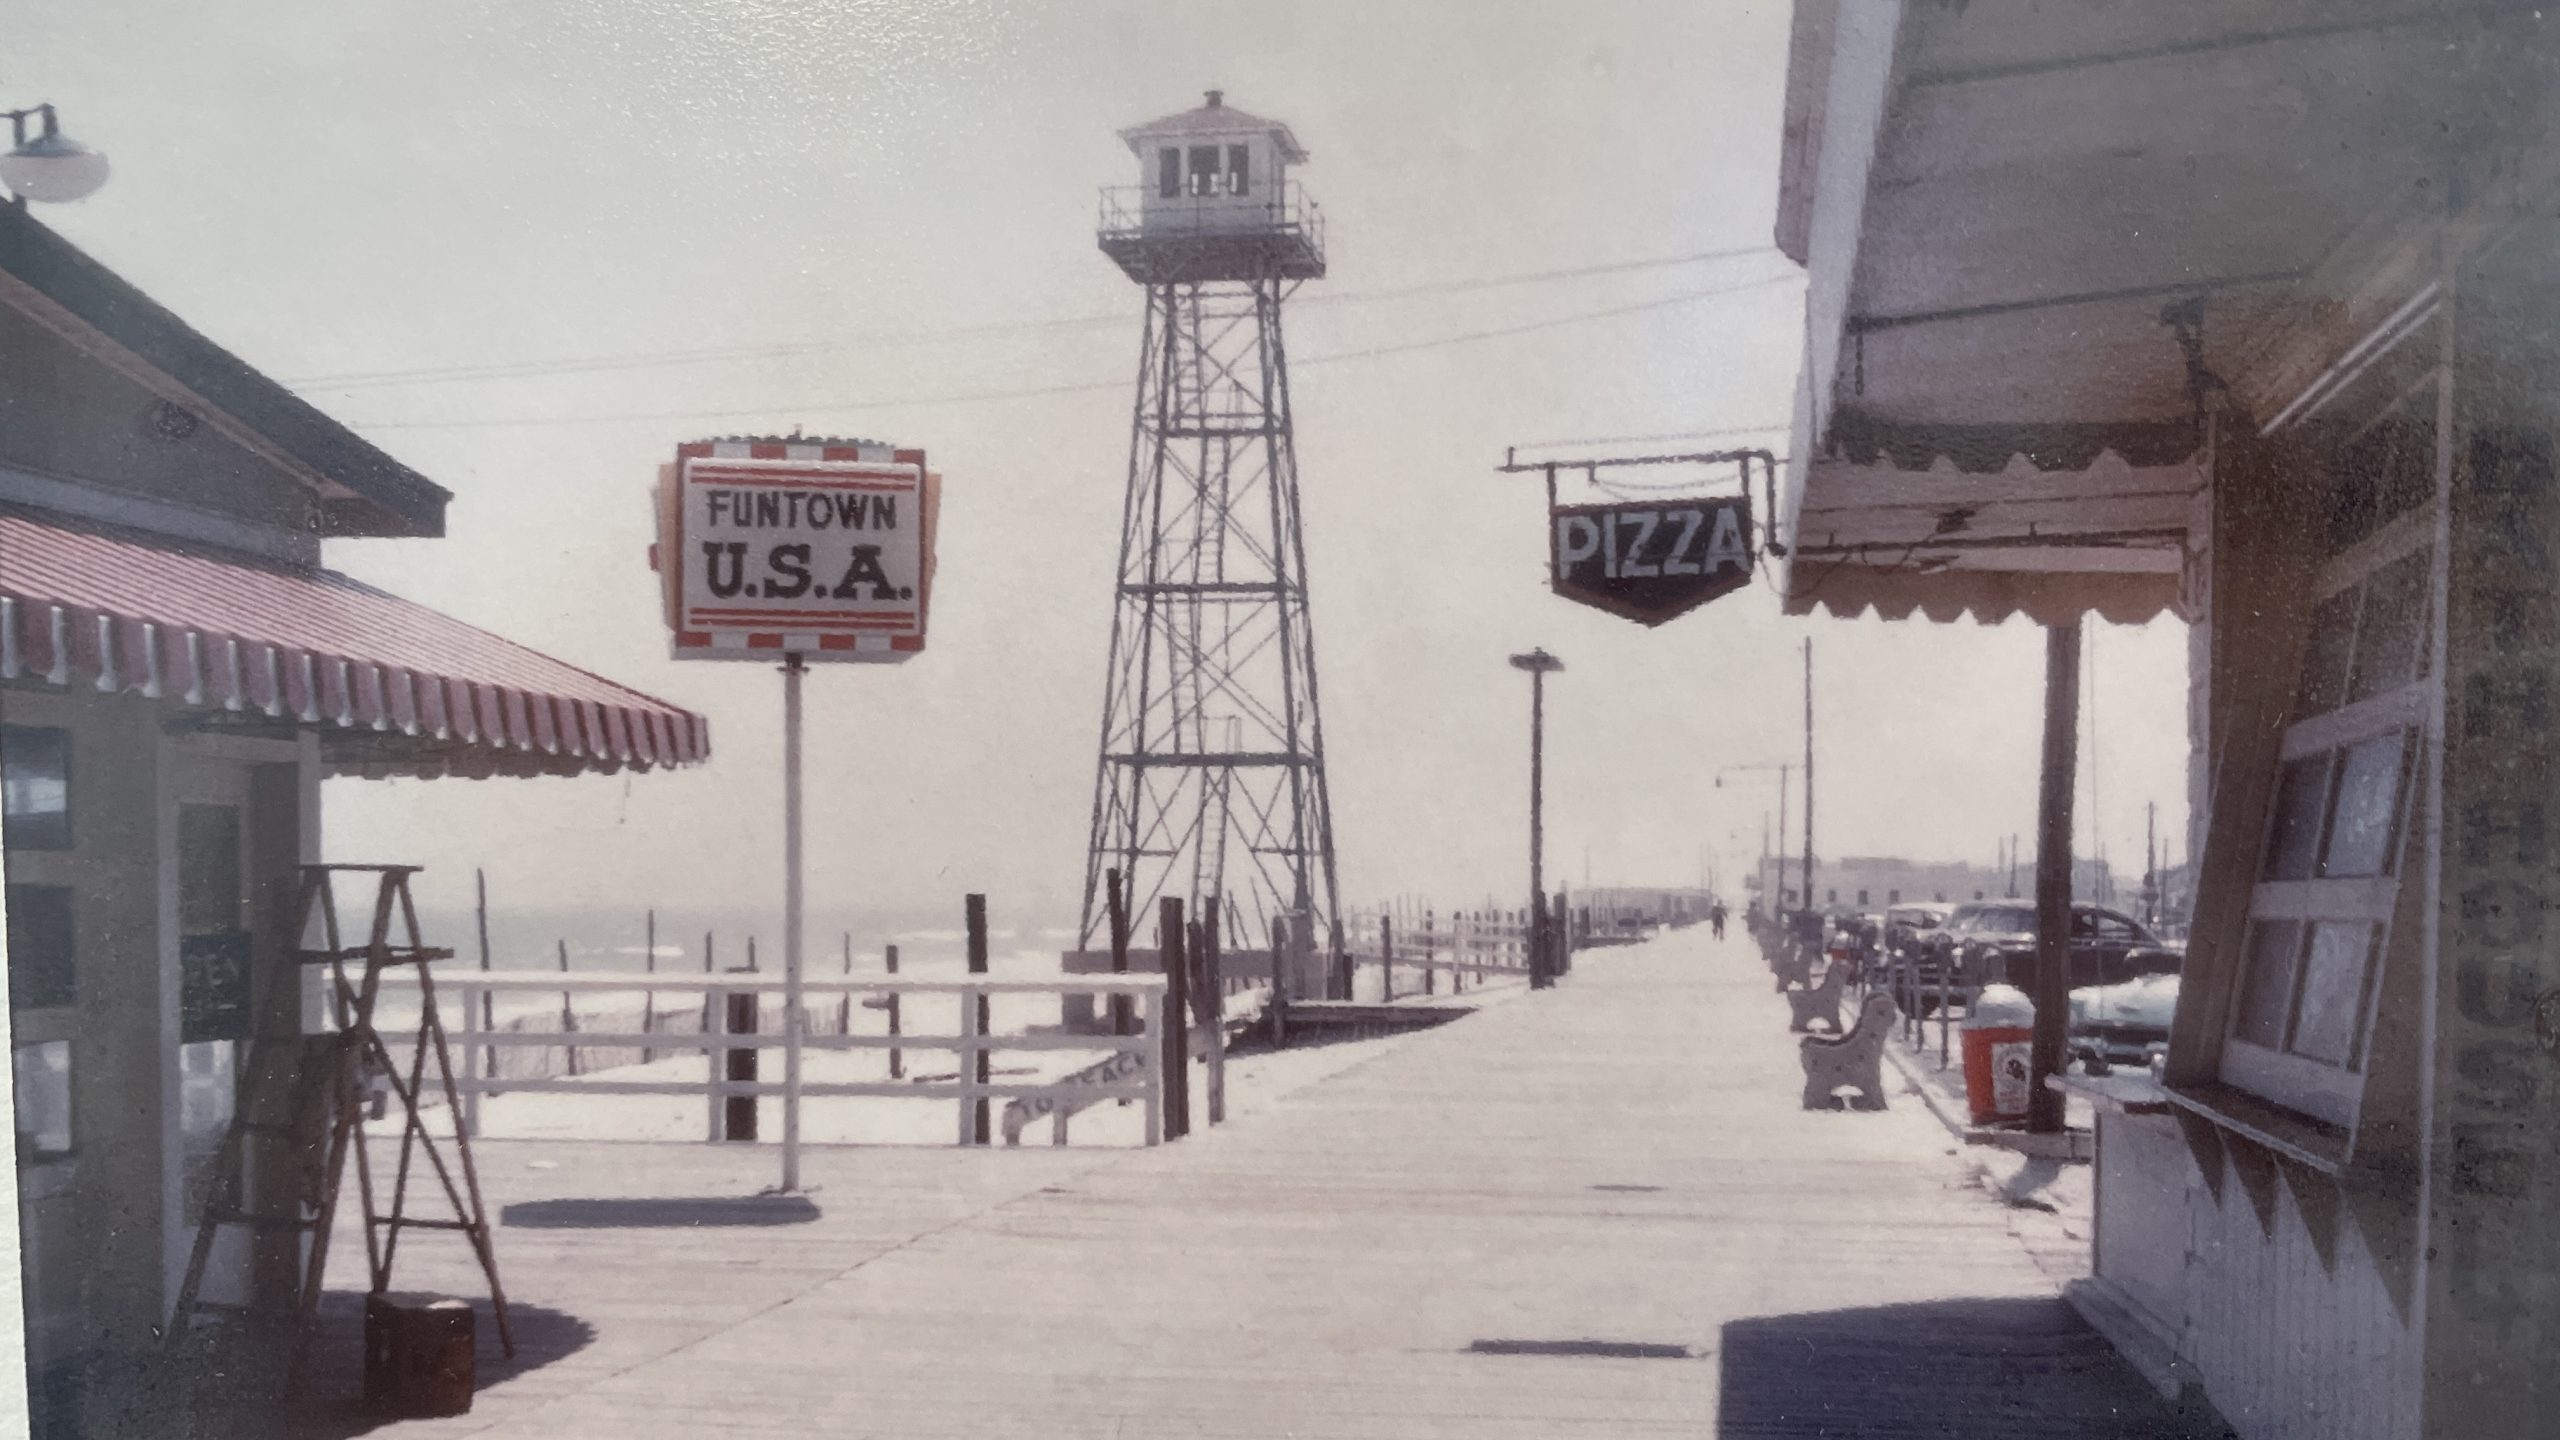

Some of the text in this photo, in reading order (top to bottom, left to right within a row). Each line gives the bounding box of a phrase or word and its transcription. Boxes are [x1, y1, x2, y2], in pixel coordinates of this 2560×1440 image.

[706, 490, 897, 530] FUNTOWN
[702, 541, 913, 600] U.S.A.
[1556, 504, 1750, 580] PIZZA
